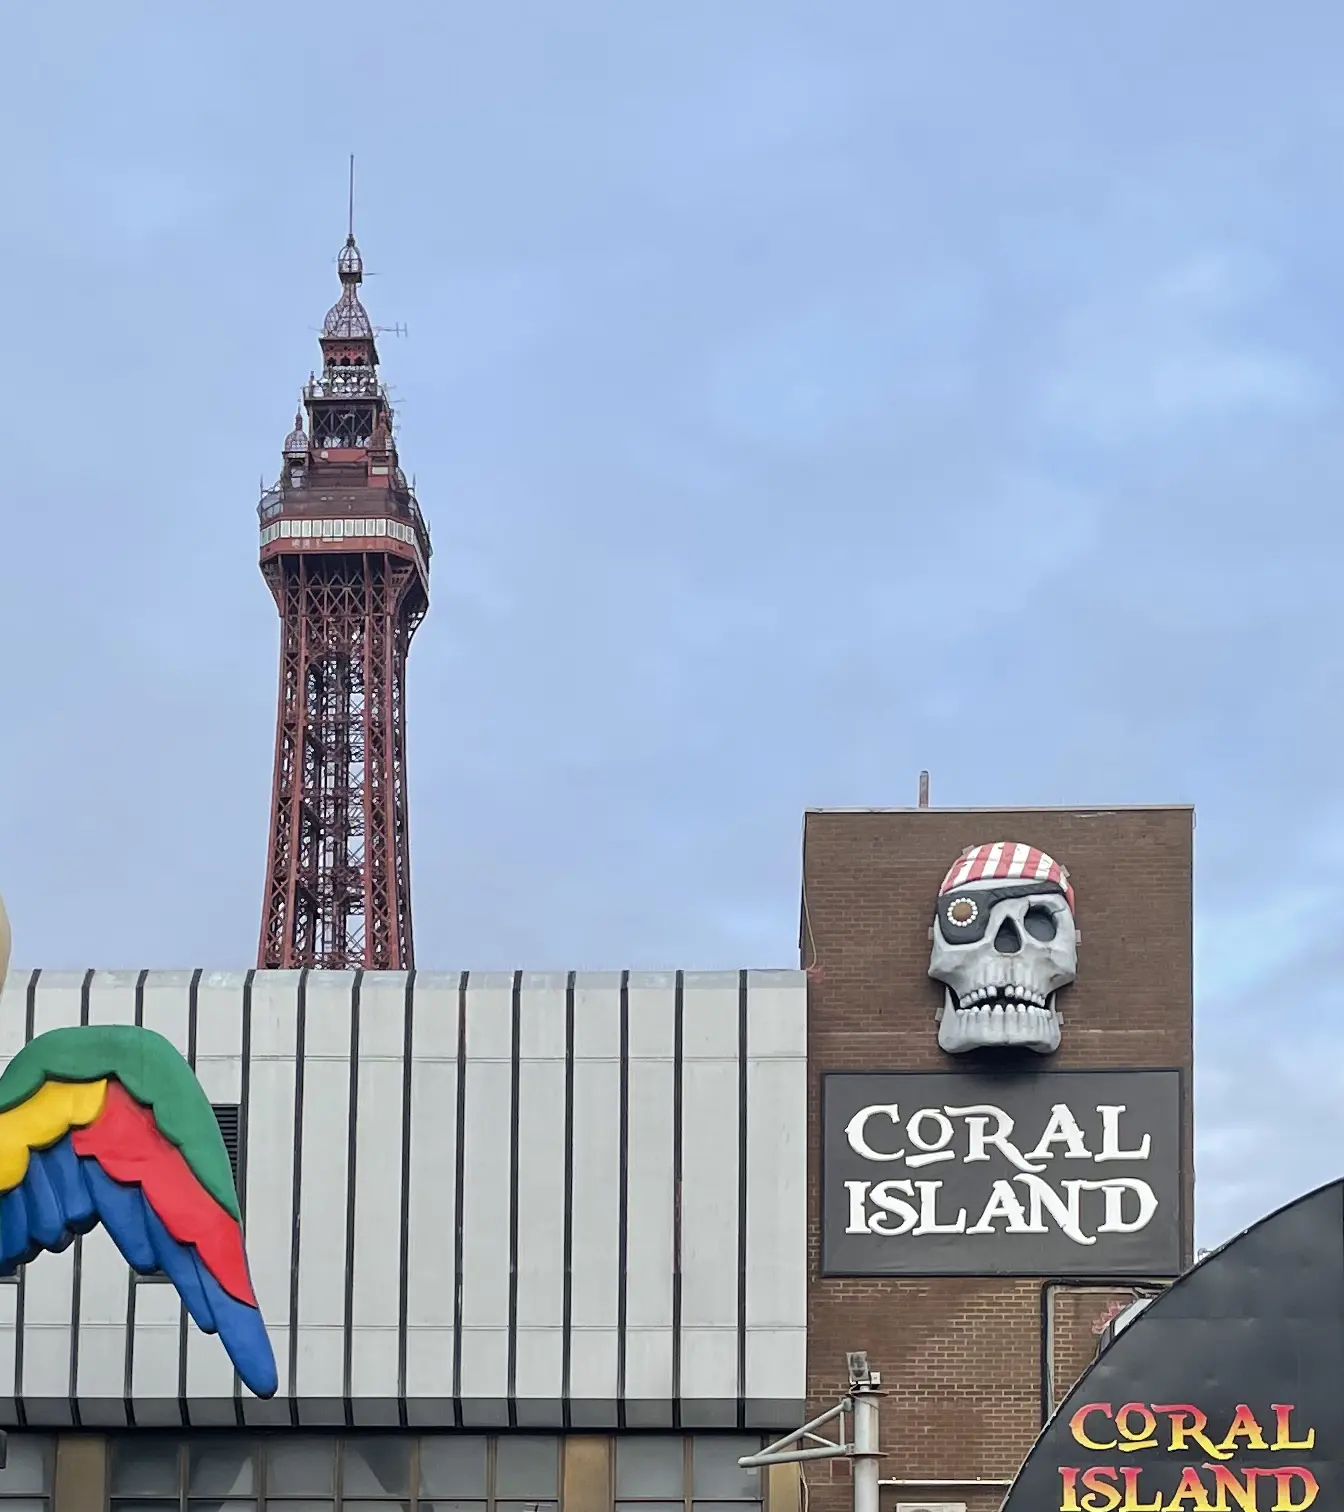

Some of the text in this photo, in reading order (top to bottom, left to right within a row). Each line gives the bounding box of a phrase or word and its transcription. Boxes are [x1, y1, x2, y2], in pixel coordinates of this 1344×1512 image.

[844, 1103, 1152, 1173] CORAL
[844, 1173, 1159, 1245] ISLAND
[1069, 1402, 1315, 1460] CORAL
